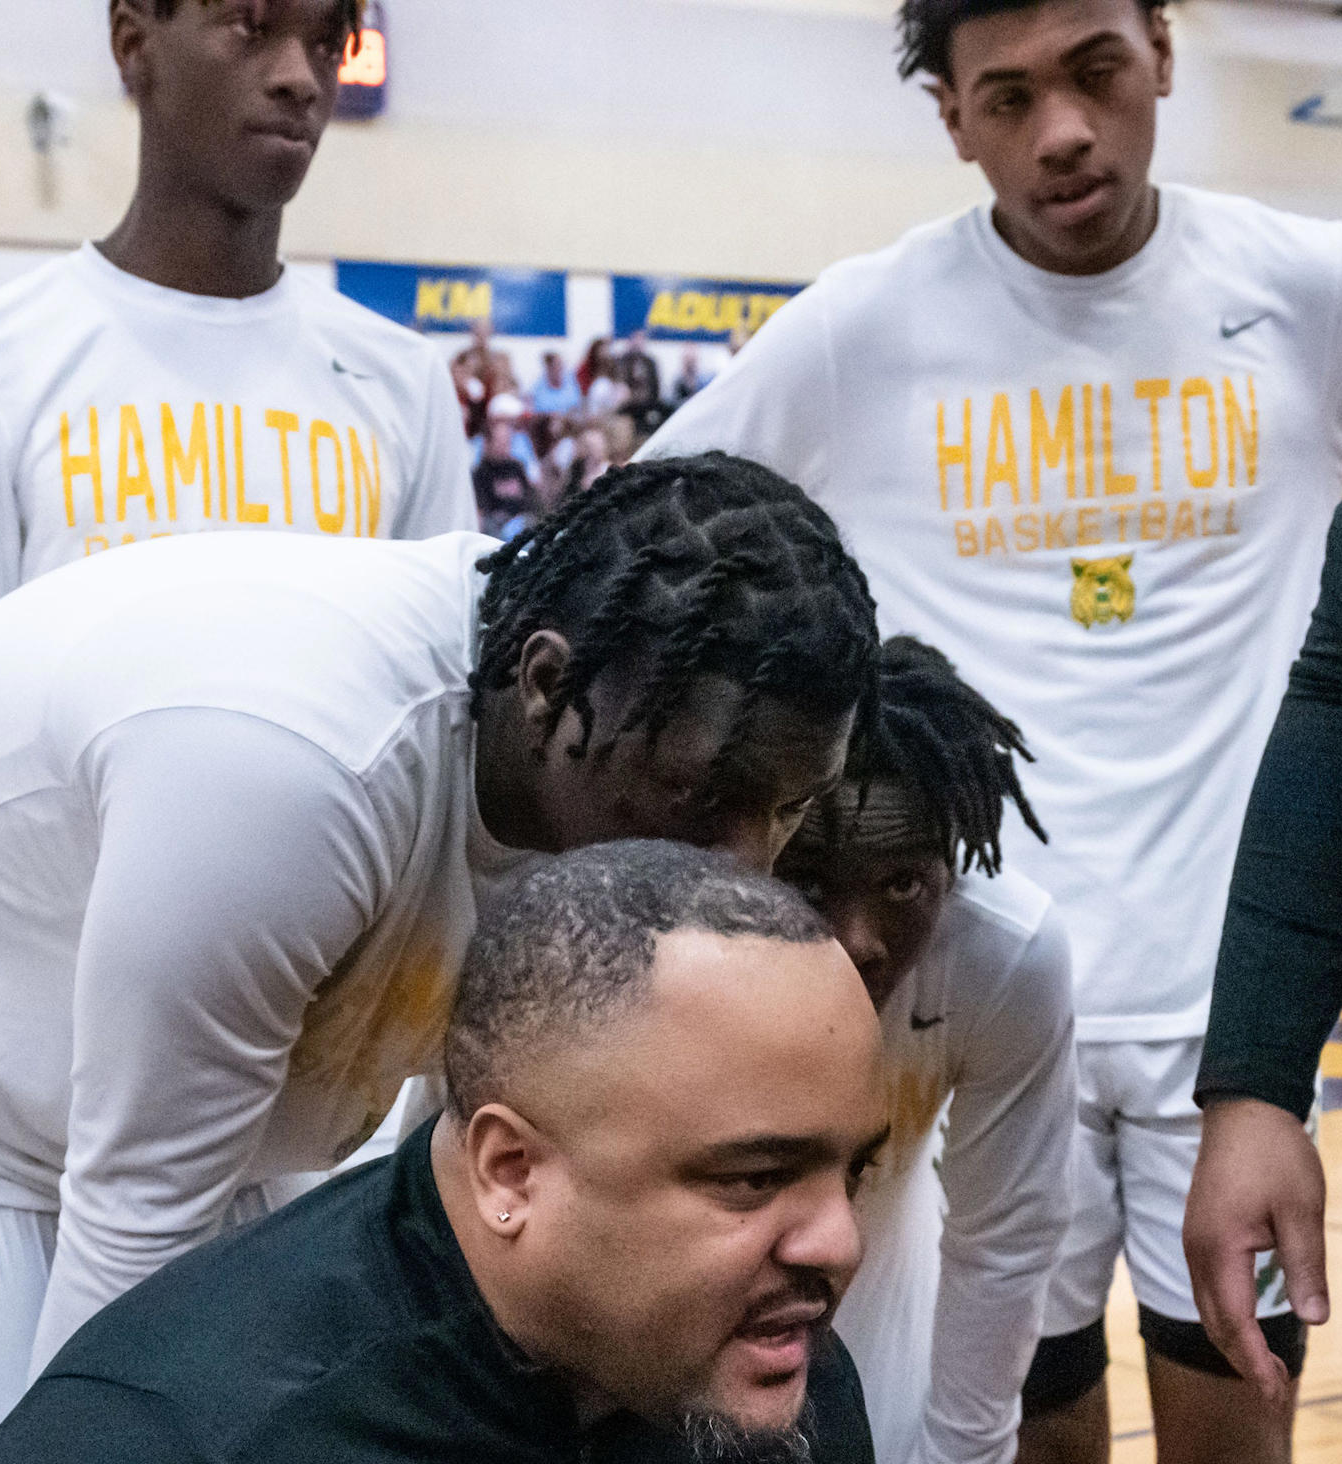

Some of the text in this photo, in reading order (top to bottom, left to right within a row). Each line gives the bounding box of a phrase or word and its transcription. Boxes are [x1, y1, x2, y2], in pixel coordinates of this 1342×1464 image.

[417, 280, 491, 319] KM
[60, 402, 382, 537] HAMILTON
[936, 373, 1258, 511] HAMILTON
[955, 499, 1240, 557] BASKETBALL
